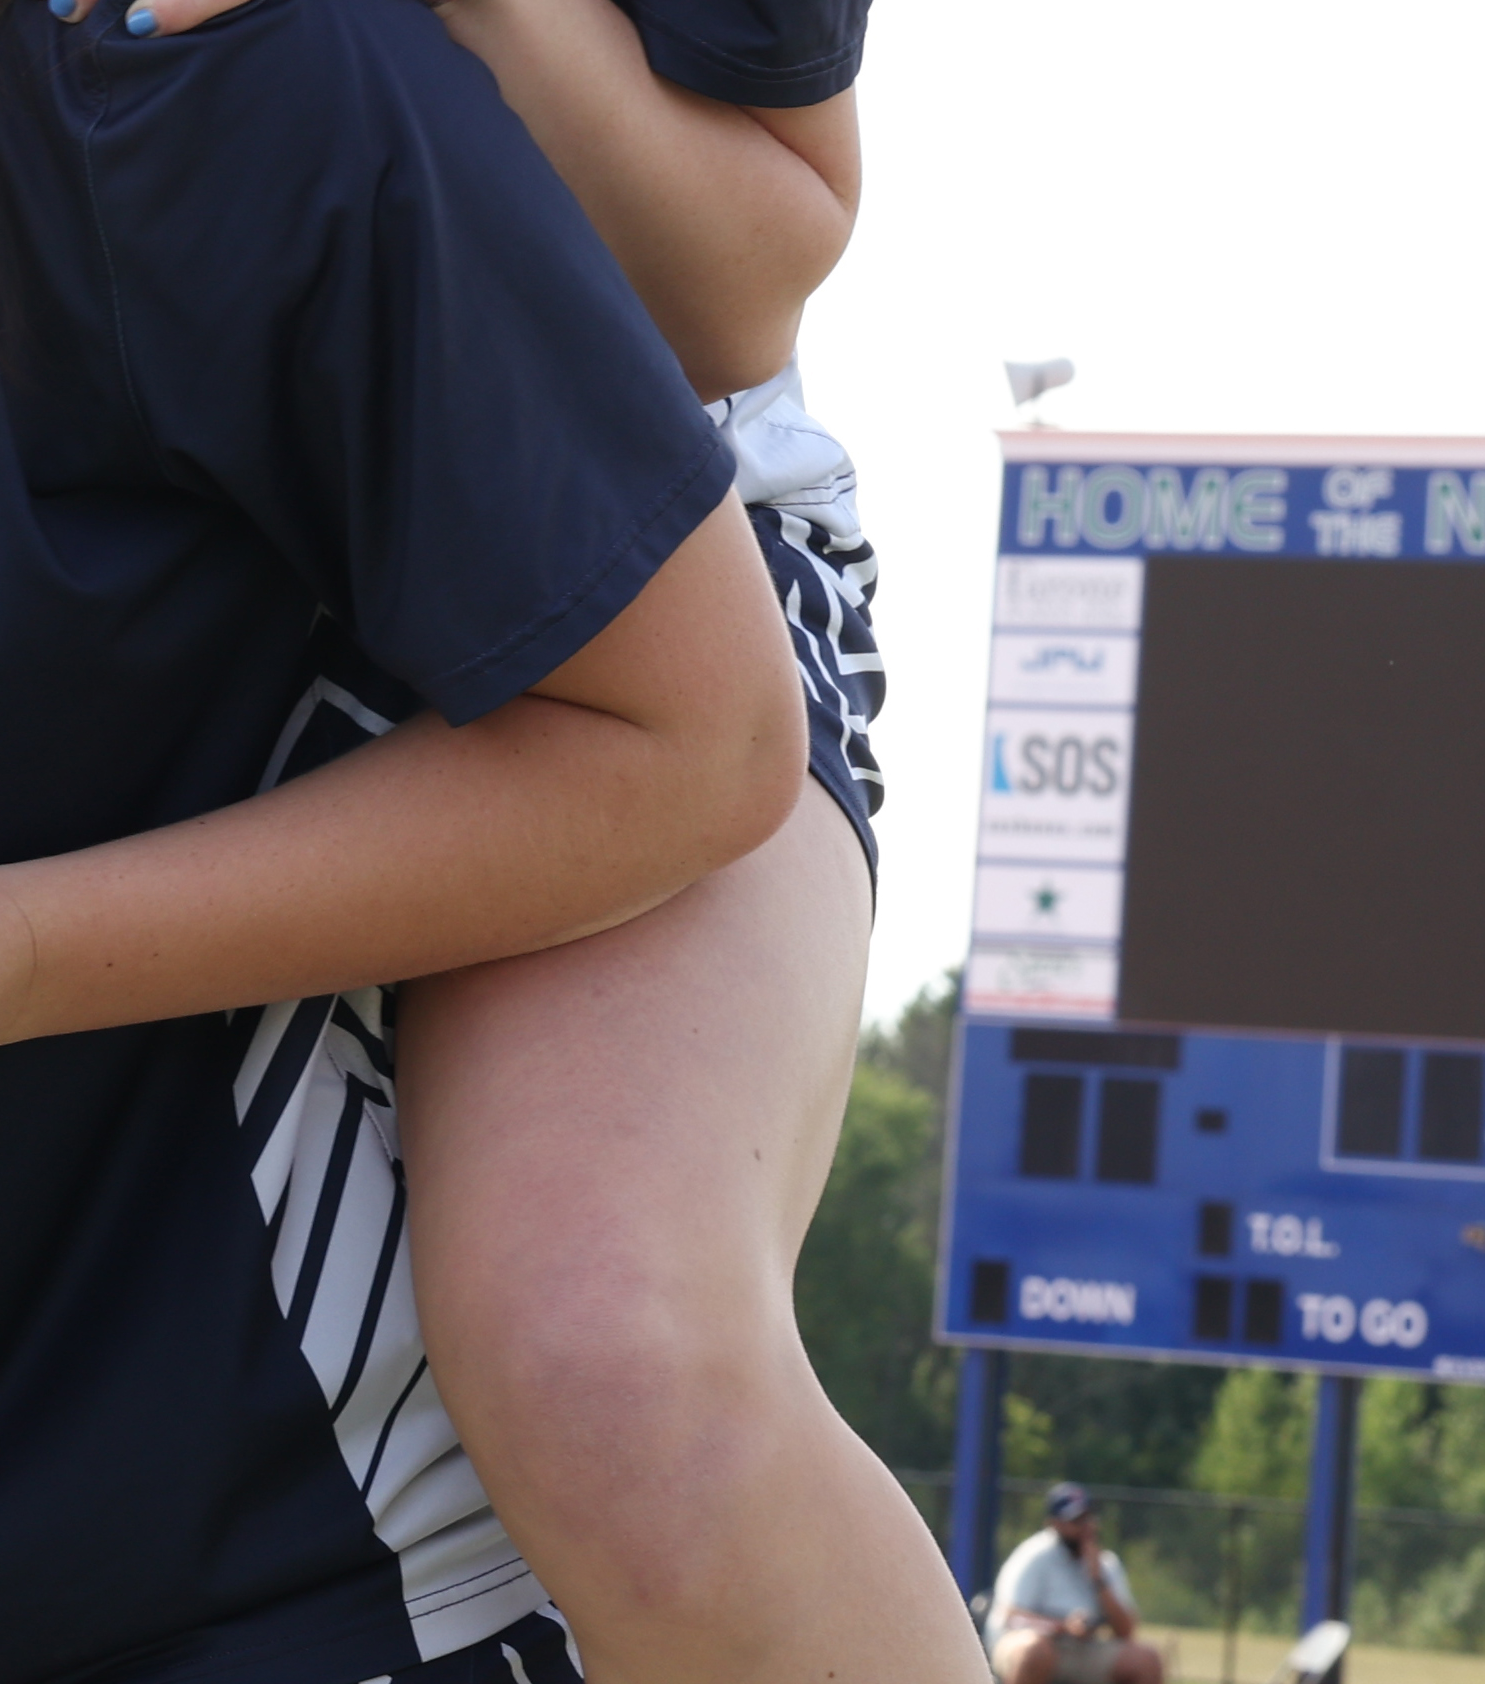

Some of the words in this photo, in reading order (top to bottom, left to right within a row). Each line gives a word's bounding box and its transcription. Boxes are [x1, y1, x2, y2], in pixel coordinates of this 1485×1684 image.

[1017, 464, 1288, 552] HOME
[1323, 466, 1396, 510] OF
[1308, 510, 1403, 559] THE
[1018, 736, 1118, 796] SOS
[1019, 1276, 1136, 1323] DOWN
[1297, 1293, 1356, 1343] TO
[1360, 1297, 1428, 1349] GO
